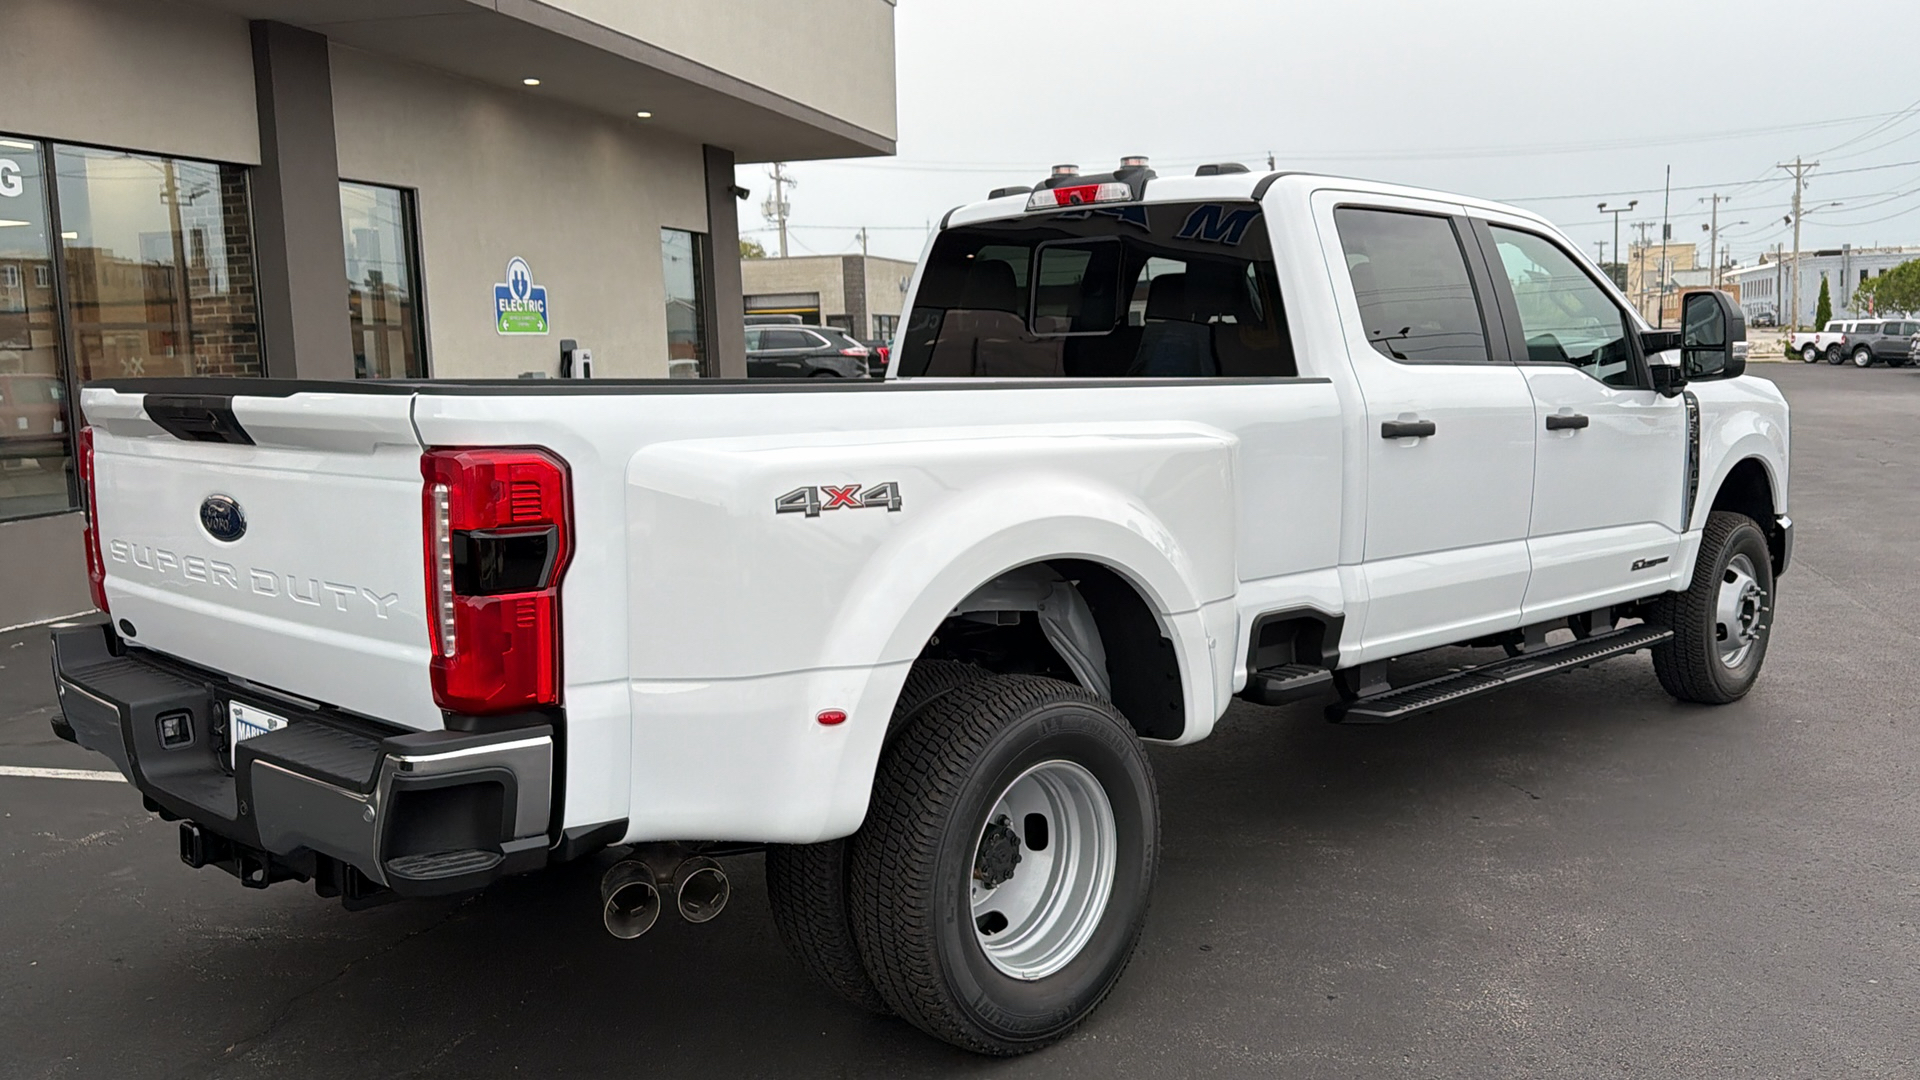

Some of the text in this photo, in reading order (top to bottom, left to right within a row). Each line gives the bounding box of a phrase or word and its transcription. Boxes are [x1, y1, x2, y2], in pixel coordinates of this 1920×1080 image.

[499, 298, 544, 313] ELECTRIC
[110, 538, 399, 620] SUPER DUTY
